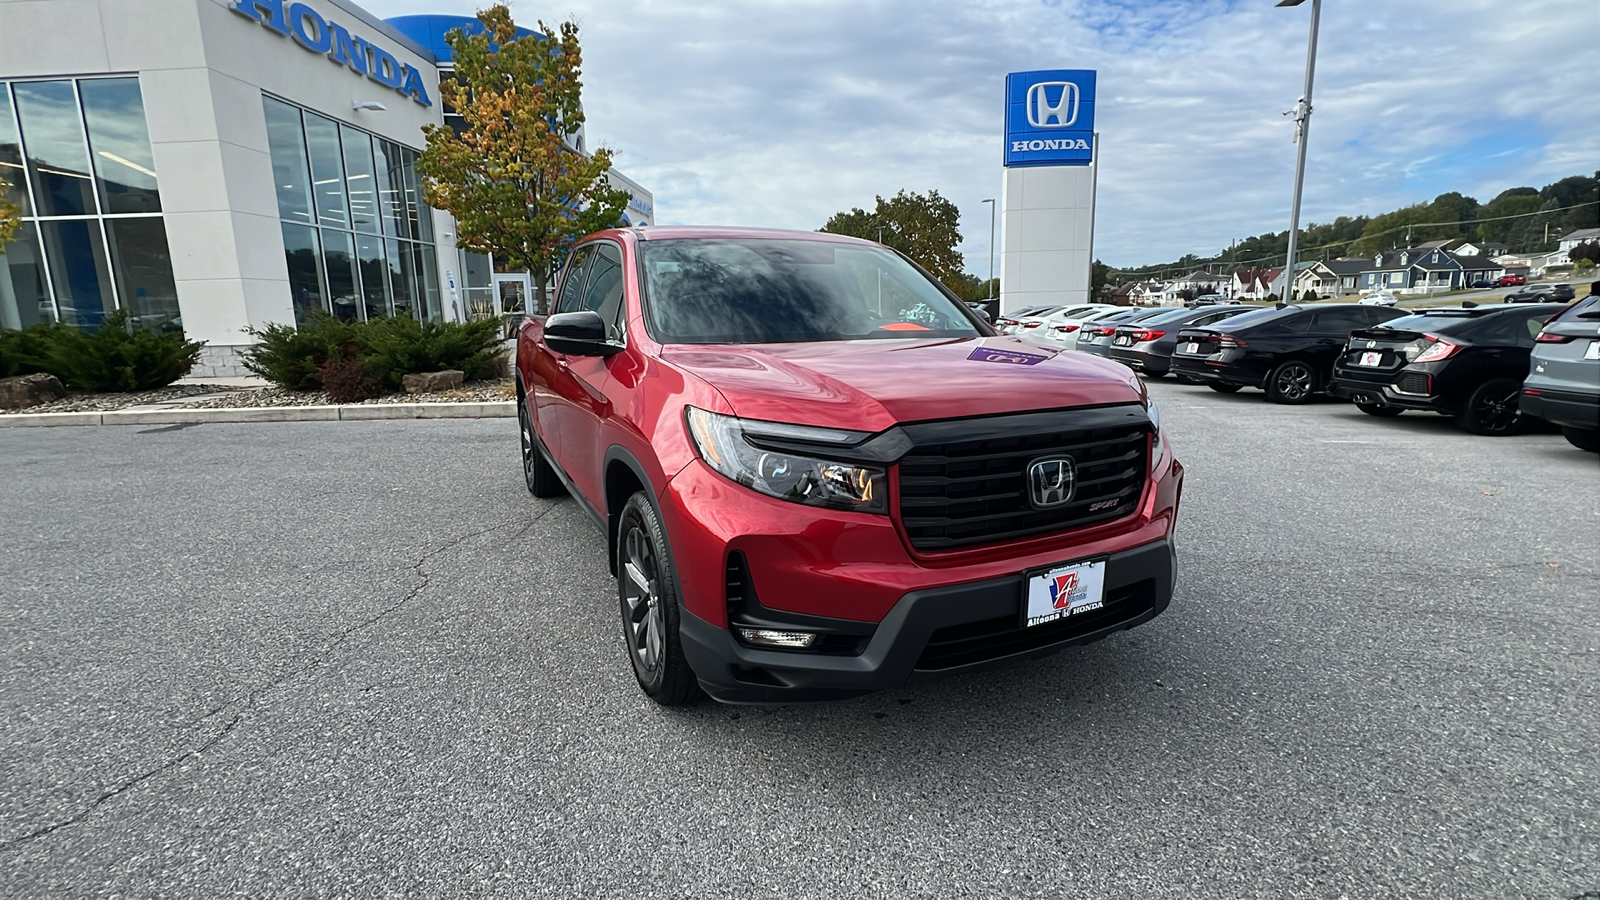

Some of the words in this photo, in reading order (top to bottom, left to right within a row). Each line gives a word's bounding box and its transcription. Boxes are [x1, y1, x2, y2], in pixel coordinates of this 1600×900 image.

[1011, 139, 1090, 152] HONDA
[1089, 498, 1119, 511] SPORT
[1027, 613, 1060, 628] Altoona
[1072, 601, 1104, 615] HONDA
